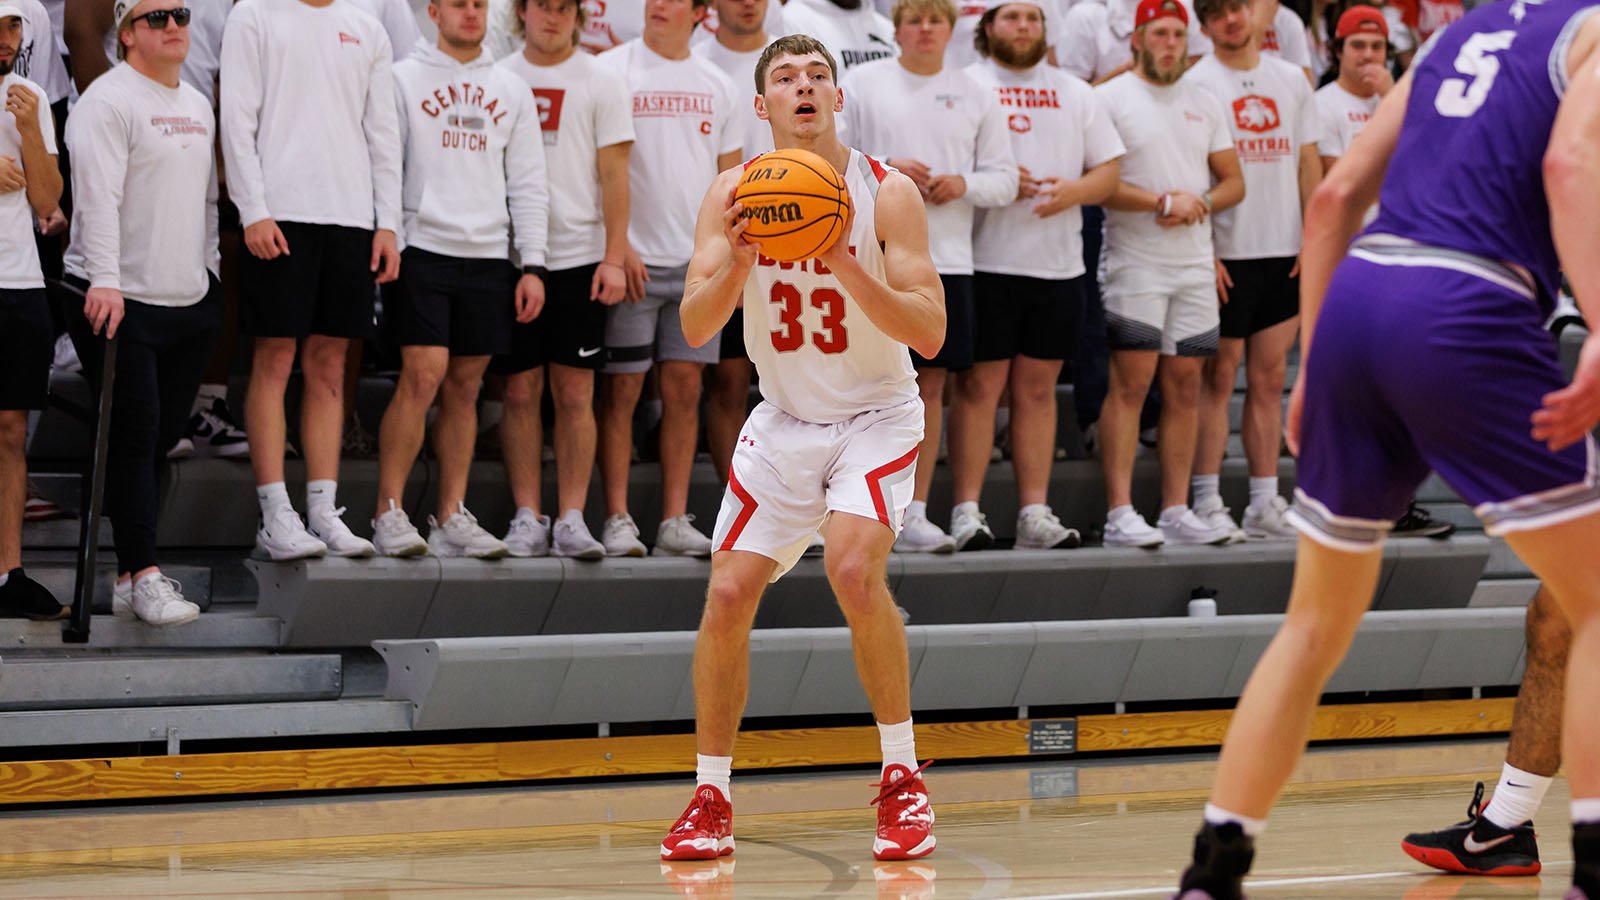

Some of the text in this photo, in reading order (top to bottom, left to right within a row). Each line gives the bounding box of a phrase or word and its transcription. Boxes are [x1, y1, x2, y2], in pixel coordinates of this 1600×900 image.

[1434, 29, 1518, 118] 5
[421, 83, 508, 126] CENTRAL
[632, 96, 714, 115] BASKETBALL
[995, 87, 1061, 109] NTRAL
[700, 121, 712, 135] C
[442, 130, 487, 152] DUTCH
[1233, 136, 1291, 154] ENTRAL
[769, 280, 849, 355] 33
